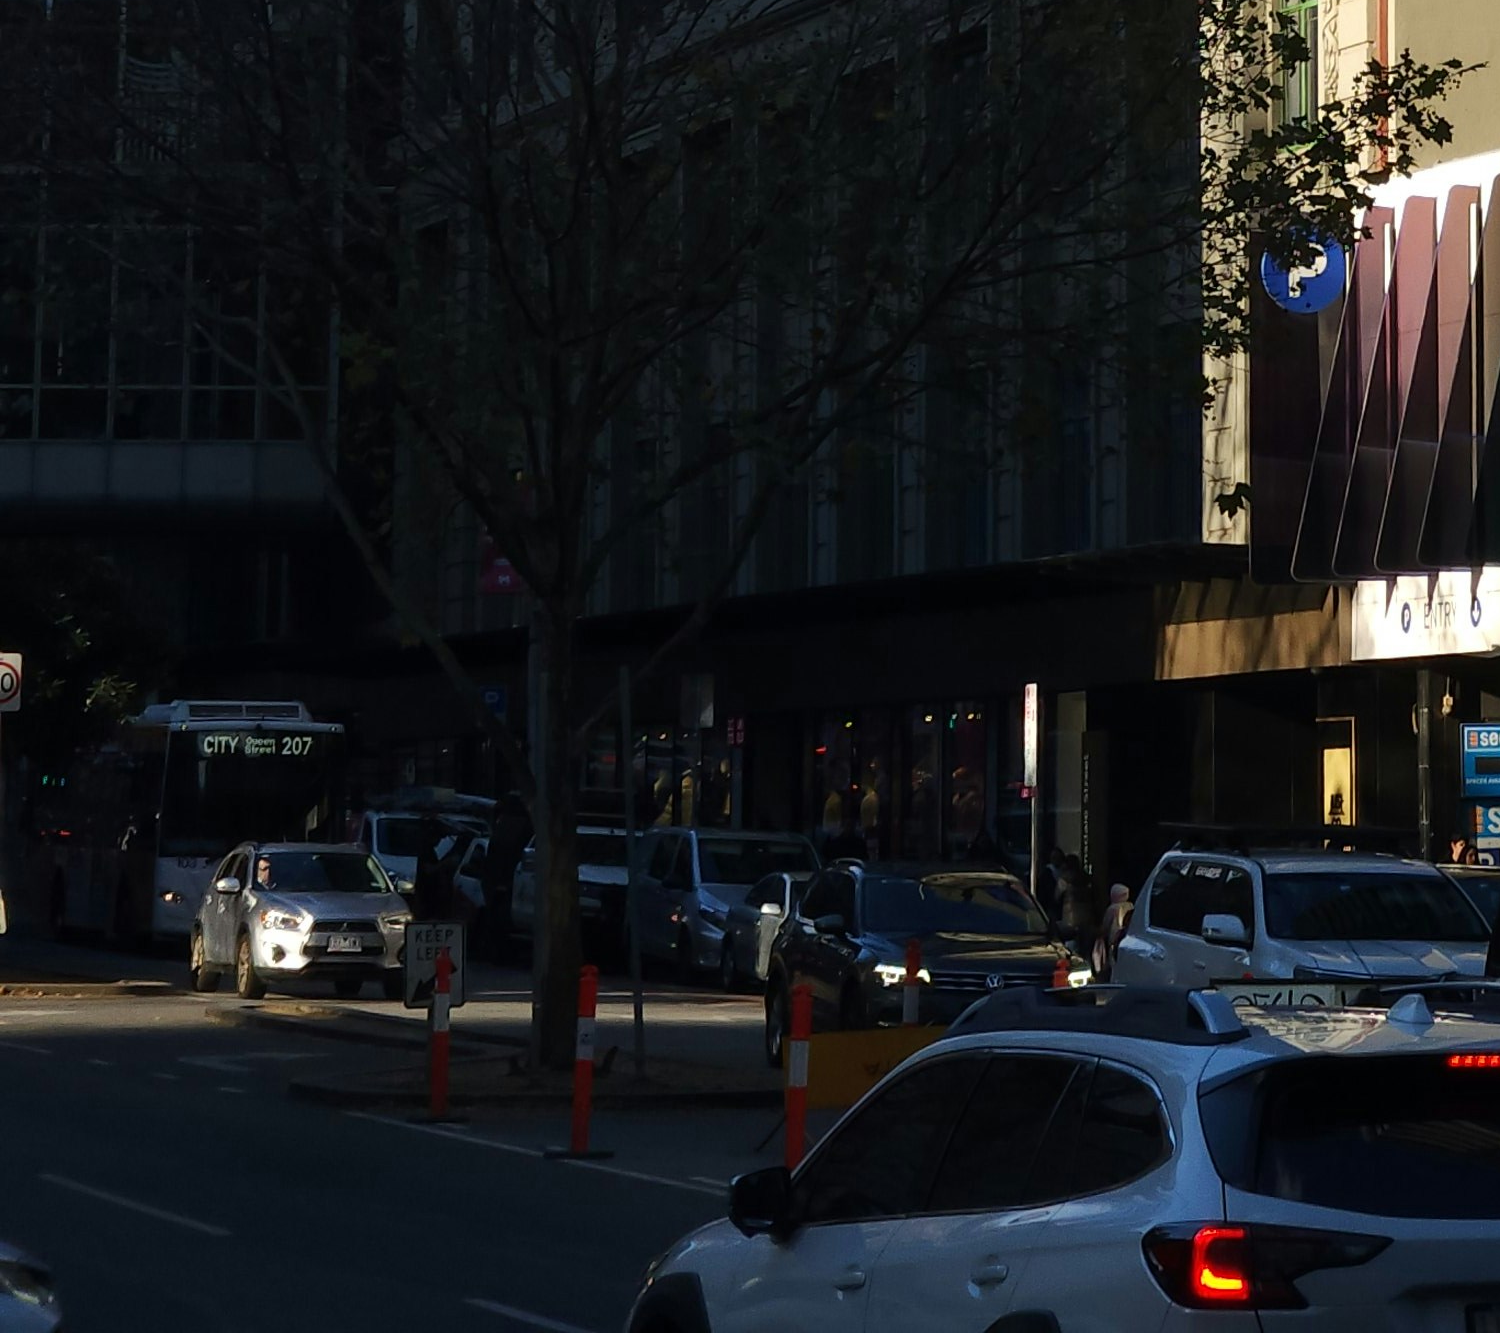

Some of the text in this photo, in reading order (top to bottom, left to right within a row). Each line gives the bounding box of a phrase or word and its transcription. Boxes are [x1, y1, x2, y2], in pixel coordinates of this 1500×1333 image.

[1423, 601, 1456, 630] ENTRY
[203, 735, 239, 754] CITY
[281, 735, 313, 755] 207
[415, 929, 454, 942] KEEP
